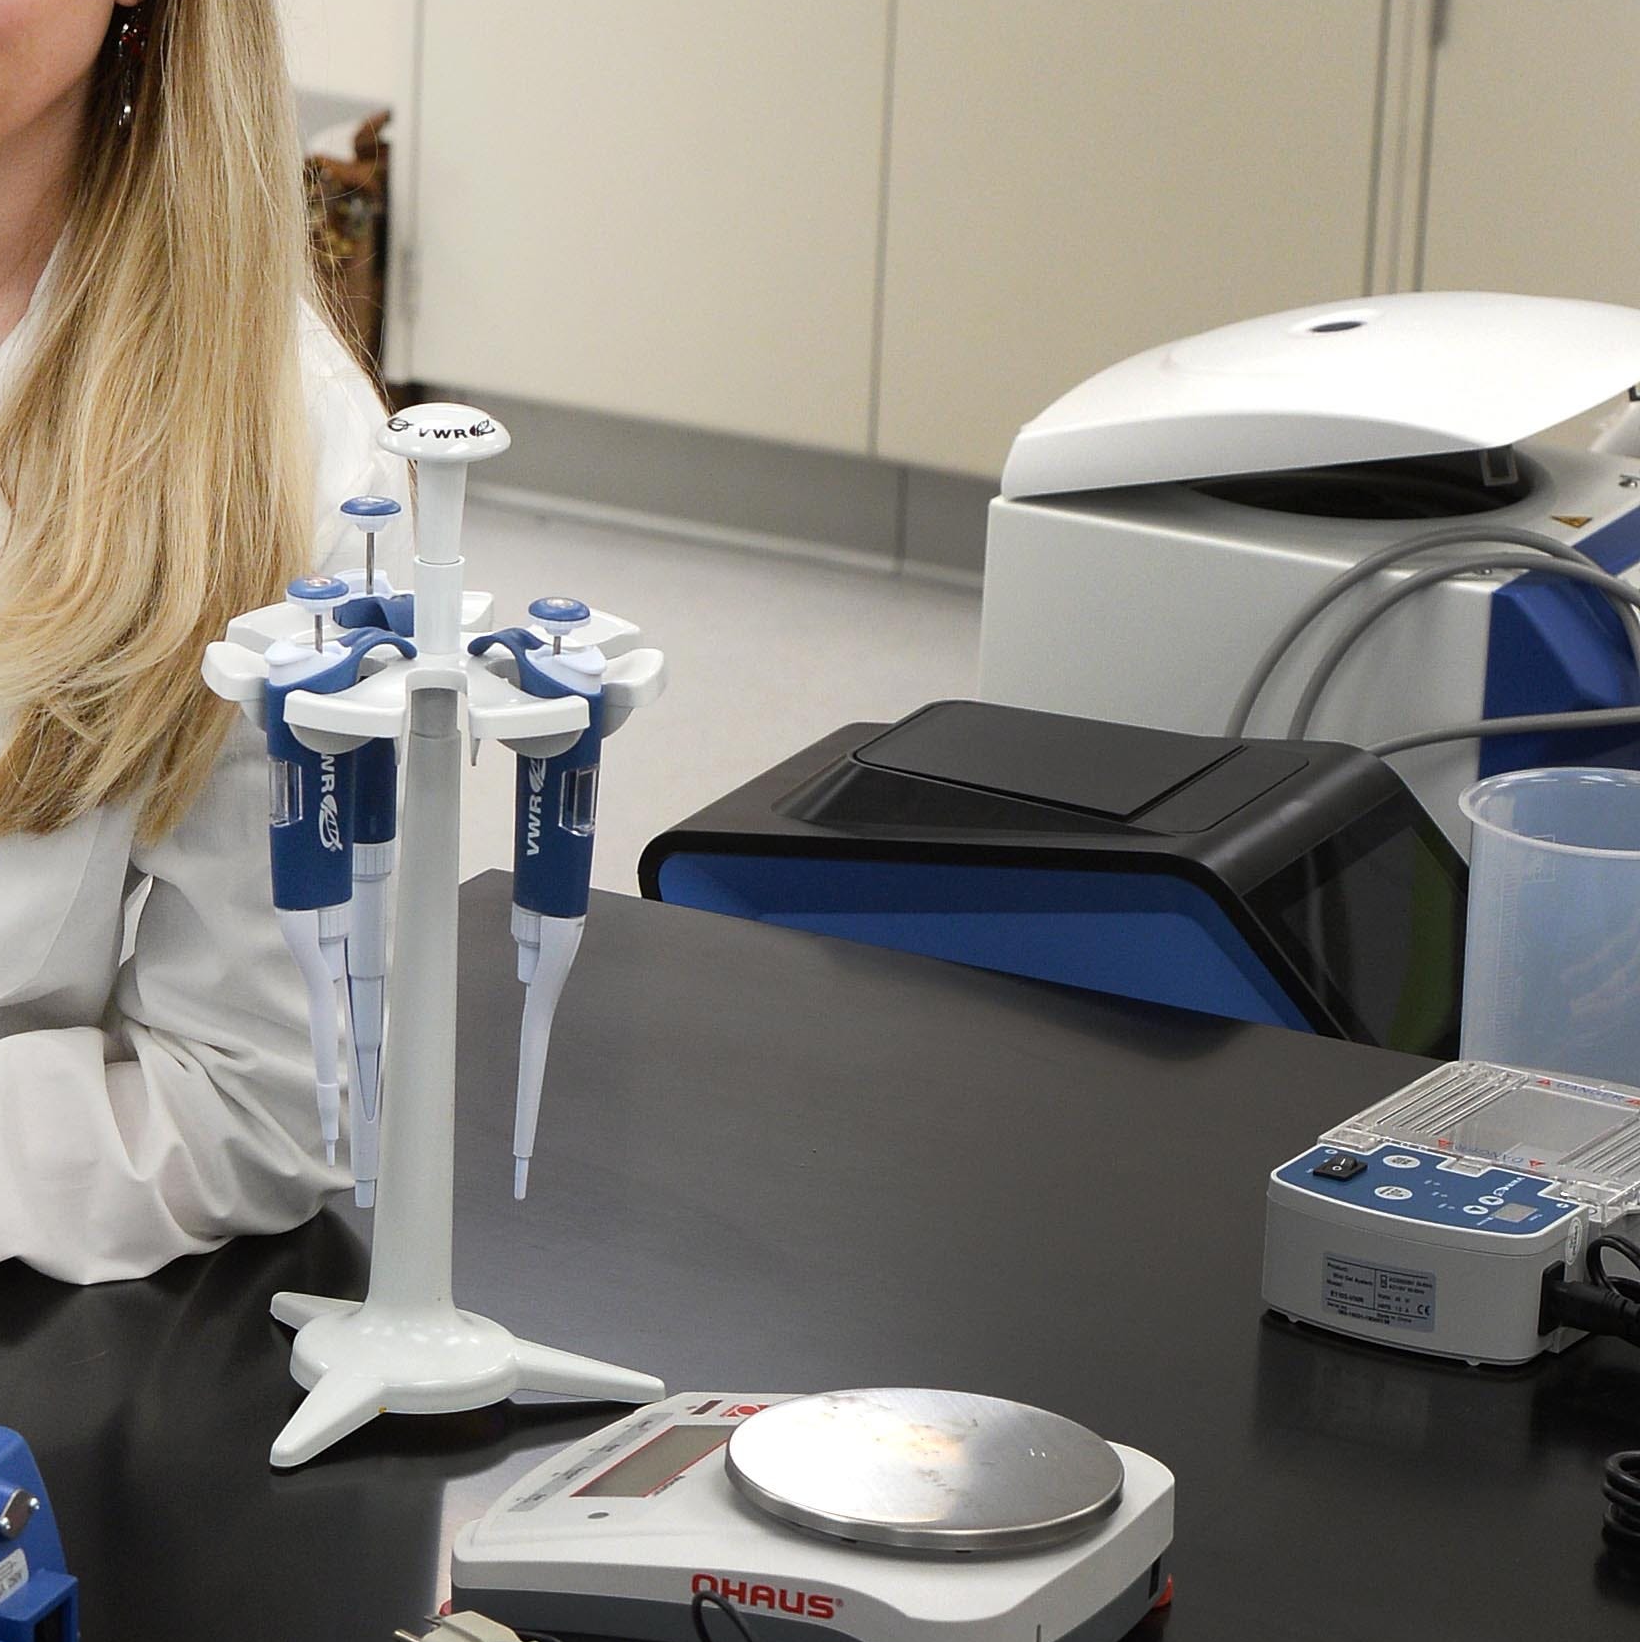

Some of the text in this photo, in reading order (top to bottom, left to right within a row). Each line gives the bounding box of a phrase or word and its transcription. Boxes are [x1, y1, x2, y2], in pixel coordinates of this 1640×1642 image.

[418, 427, 468, 440] VWR
[320, 752, 336, 793] WR
[526, 795, 542, 856] VWR
